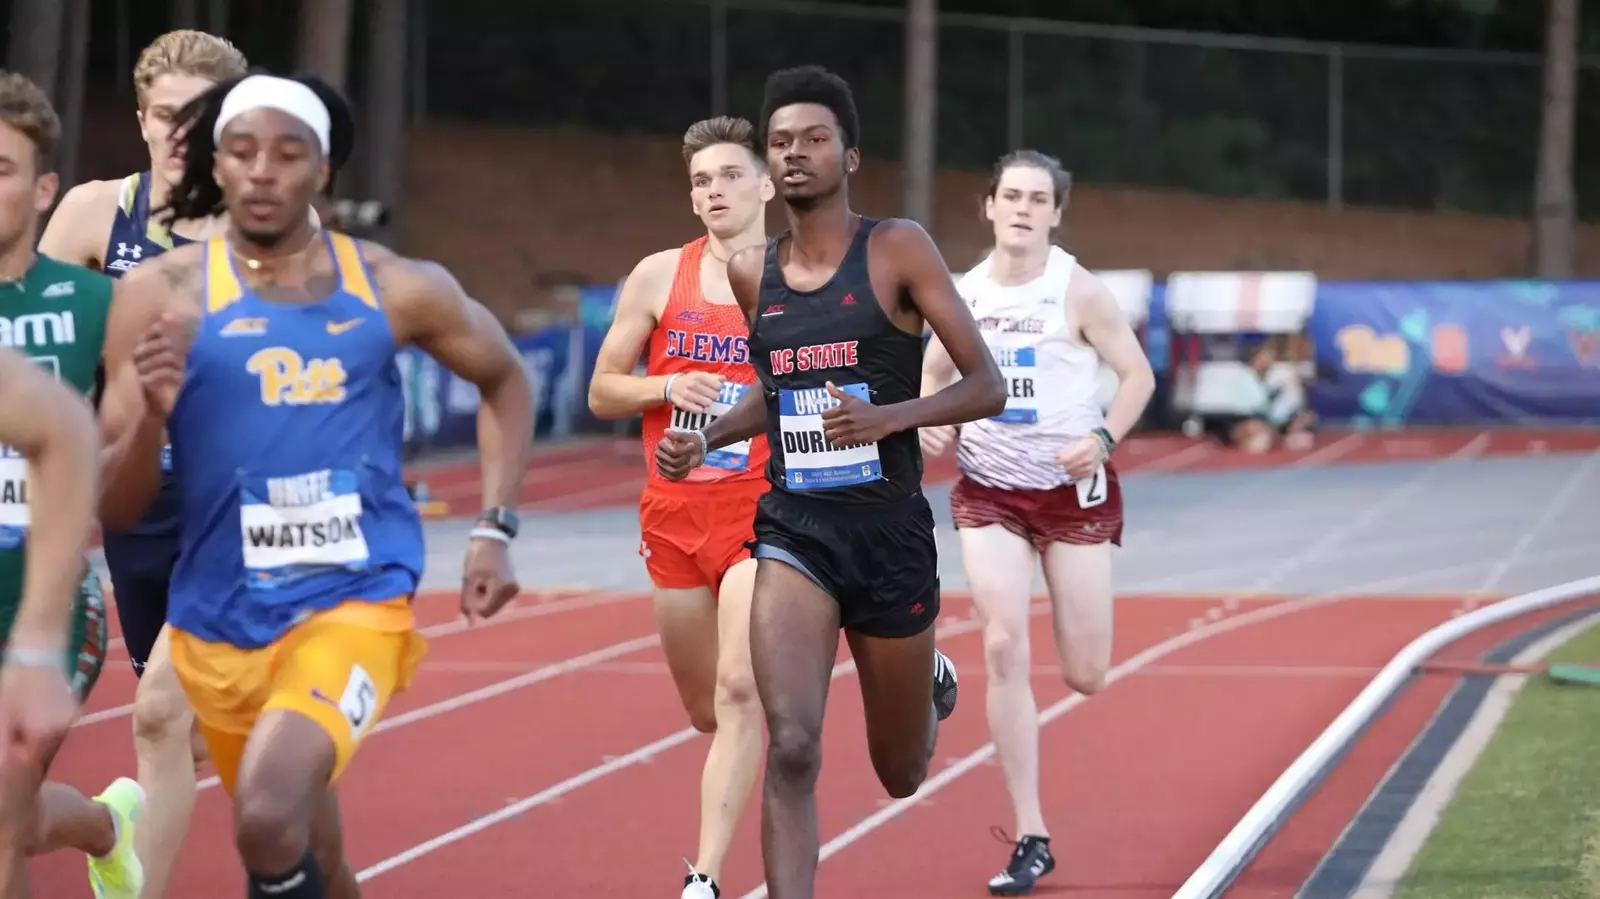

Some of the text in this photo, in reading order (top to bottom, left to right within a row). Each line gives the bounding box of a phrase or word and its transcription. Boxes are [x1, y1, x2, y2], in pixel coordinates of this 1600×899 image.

[675, 310, 704, 322] ACC
[761, 304, 785, 316] ACC
[666, 329, 752, 364] CLEMS
[770, 340, 859, 376] NC STATE
[245, 346, 349, 408] Pitt
[783, 430, 874, 454] DUR
[248, 515, 357, 548] WATSON
[348, 678, 375, 728] 5
